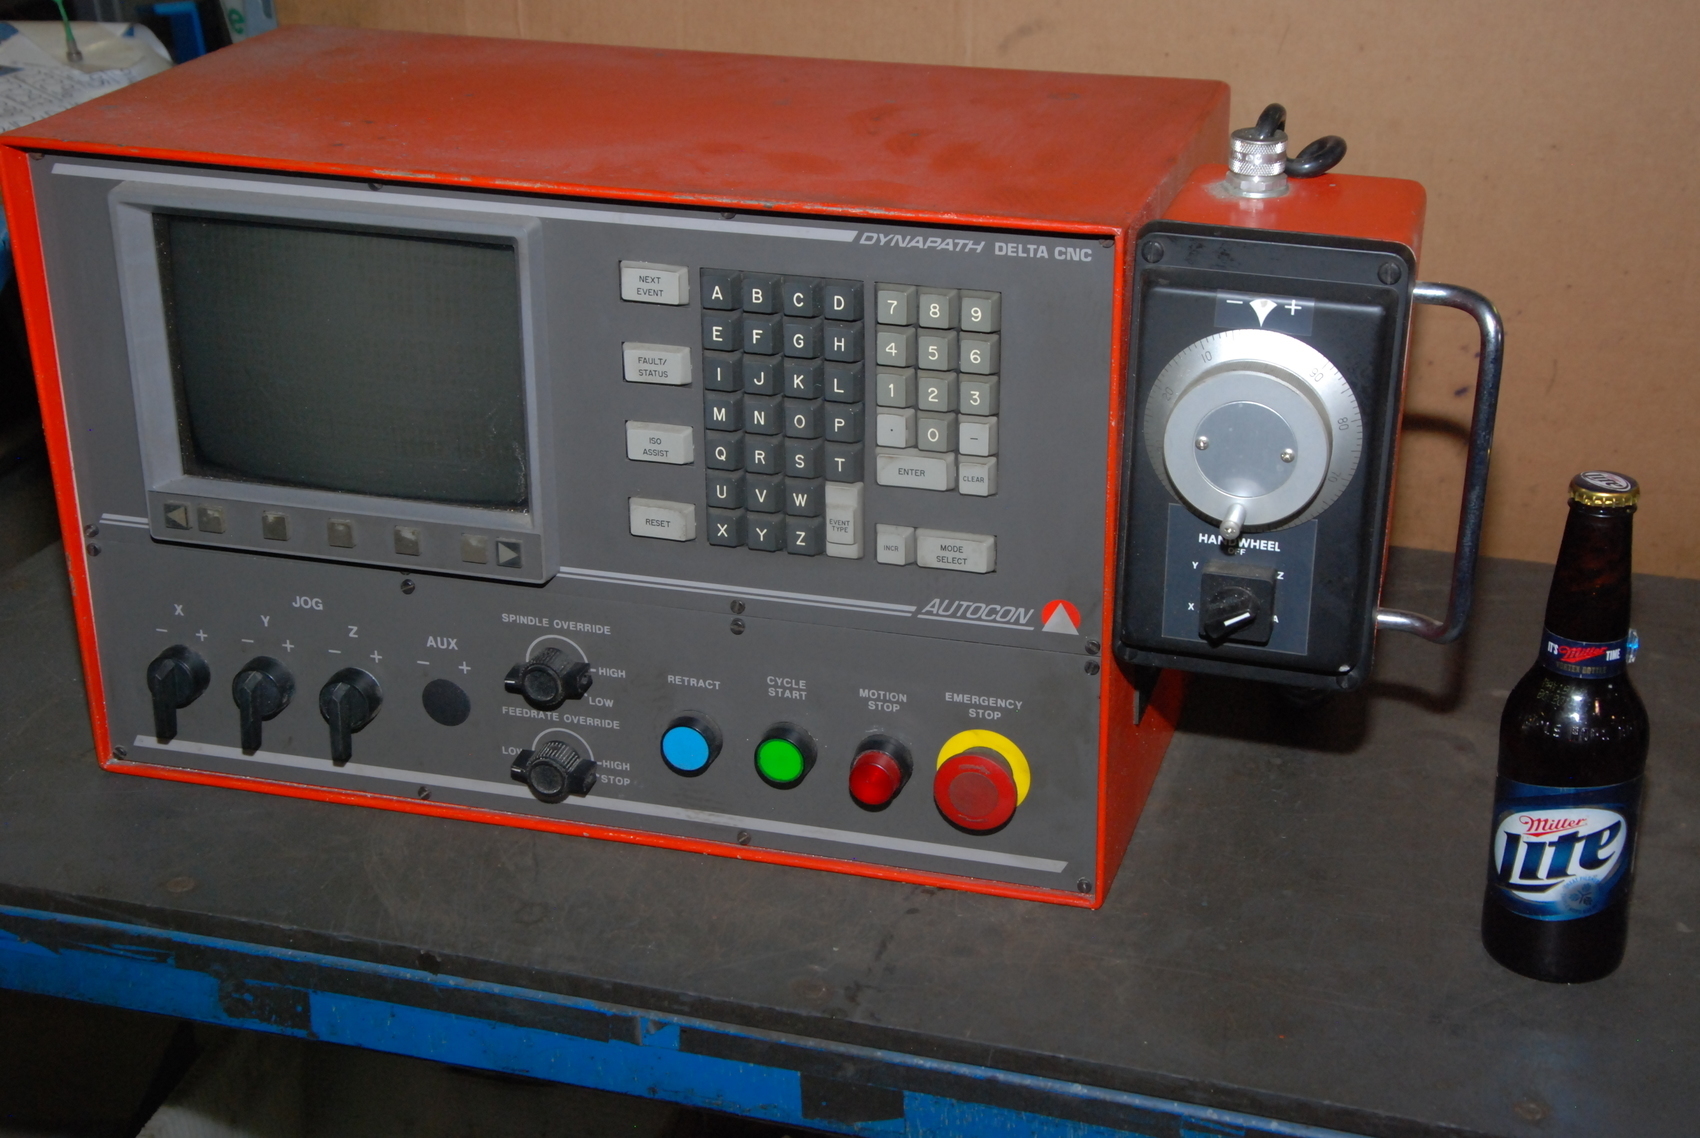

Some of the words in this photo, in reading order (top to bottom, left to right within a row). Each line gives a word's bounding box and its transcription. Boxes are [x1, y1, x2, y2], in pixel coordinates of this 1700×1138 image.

[859, 232, 986, 254] DYNAPATH
[994, 241, 1049, 259] DELTA
[1054, 246, 1093, 262] CNC
[638, 275, 661, 285] NEXT
[636, 287, 664, 297] EVENT
[711, 285, 723, 301] A
[752, 288, 763, 304] B
[793, 292, 804, 308] C
[833, 295, 845, 311] D
[887, 299, 898, 315] 7
[929, 303, 940, 318] 8
[970, 307, 982, 322] 9
[712, 326, 723, 342] E
[752, 329, 763, 344] F
[793, 333, 804, 349] G
[834, 336, 845, 352] H
[885, 342, 898, 357] 4
[928, 345, 939, 361] 5
[969, 349, 981, 364] 6
[637, 356, 668, 366] FAULT/
[638, 368, 669, 379] STATUS
[753, 371, 765, 386] J
[793, 374, 805, 390] K
[833, 378, 845, 393] L
[927, 387, 939, 402] 2
[969, 390, 981, 406] 3
[713, 406, 726, 422] M
[753, 410, 765, 426] N
[793, 414, 806, 429] O
[834, 418, 845, 433] P
[1337, 416, 1349, 431] 80
[648, 436, 662, 446] ISO
[642, 448, 670, 458] ASSIST
[715, 446, 727, 462] Q
[754, 449, 766, 465] R
[794, 454, 805, 469] S
[834, 457, 846, 472] T
[897, 467, 926, 477] ENTER
[962, 474, 985, 484] CLEAR
[716, 484, 727, 499] U
[755, 488, 767, 503] V
[792, 492, 808, 507] W
[645, 518, 671, 528] RESET
[717, 523, 728, 538] X
[828, 518, 851, 528] EVENT
[831, 525, 849, 534] TYPE
[755, 527, 768, 542] Y
[795, 531, 806, 546] Z
[883, 543, 899, 552] INCR
[940, 544, 964, 554] MODE
[935, 555, 968, 565] SELECT
[1191, 561, 1199, 570] Y
[1276, 571, 1285, 580] Z
[173, 603, 185, 617] X
[291, 595, 324, 611] JOG
[1187, 602, 1195, 611] X
[921, 597, 1035, 625] AUTOCON
[260, 614, 270, 628] Y
[501, 612, 550, 629] SPINDLE
[552, 618, 613, 636] OVERRIDE
[347, 625, 359, 638] Z
[426, 635, 459, 651] AUX
[1547, 641, 1559, 655] IT'S
[1605, 648, 1621, 662] TIME
[598, 666, 626, 679] HIGH
[667, 674, 721, 690] RETRACT
[766, 675, 807, 691] CYCLE
[768, 686, 808, 701] START
[859, 688, 907, 704] MOTION
[945, 691, 1023, 711] EMERGENCY
[588, 696, 614, 708] LOW
[868, 699, 900, 713] STOP
[502, 706, 560, 722] FEEDRATE
[562, 712, 620, 731] OVERRIDE
[968, 708, 1002, 720] STOP
[602, 759, 630, 771] HIGH
[600, 774, 631, 786] STOP
[1518, 814, 1588, 833] Miller
